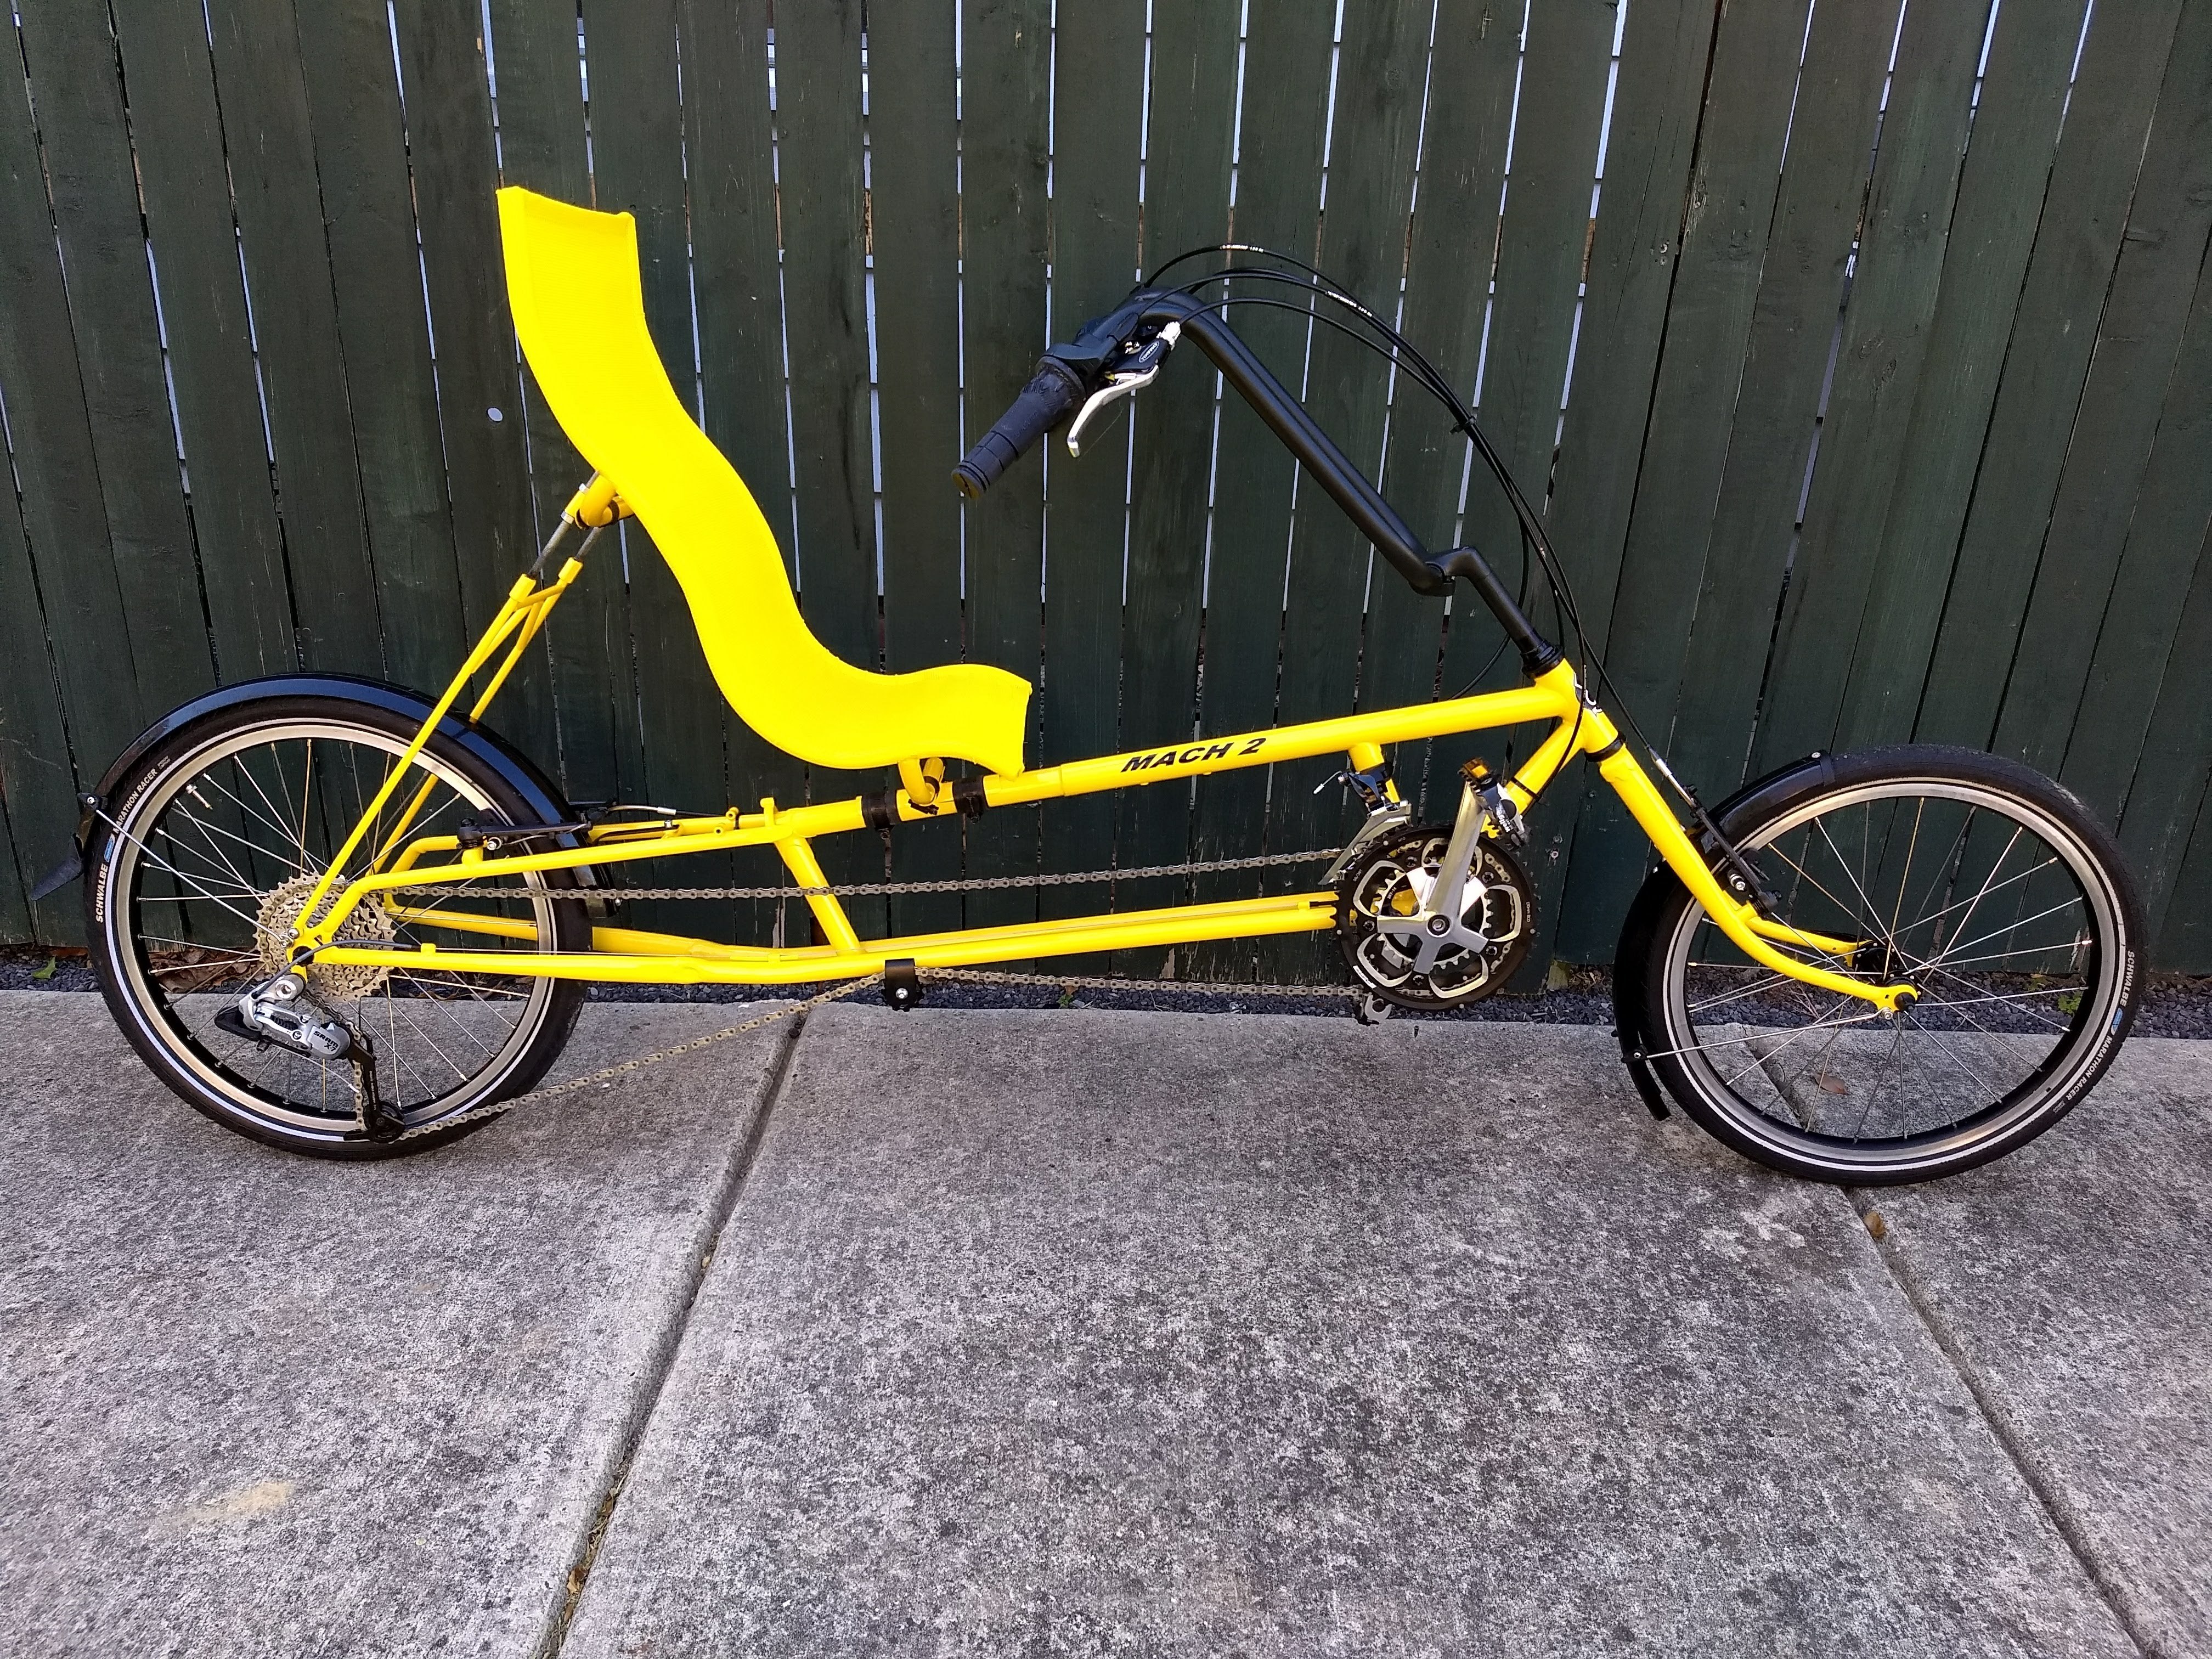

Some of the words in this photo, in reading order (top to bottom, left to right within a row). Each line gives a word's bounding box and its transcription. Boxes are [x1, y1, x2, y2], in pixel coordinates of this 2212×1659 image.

[1121, 742, 1235, 772] MACH
[1239, 738, 1267, 755] 2
[112, 791, 139, 834] MARATHON
[136, 768, 158, 793] RACER
[95, 863, 109, 923] SCHWALBE
[2119, 950, 2135, 1007] SCHWALBE
[313, 1031, 338, 1048] SRAM
[2085, 1035, 2113, 1079] MARATHON
[2066, 1076, 2087, 1101] RACER
